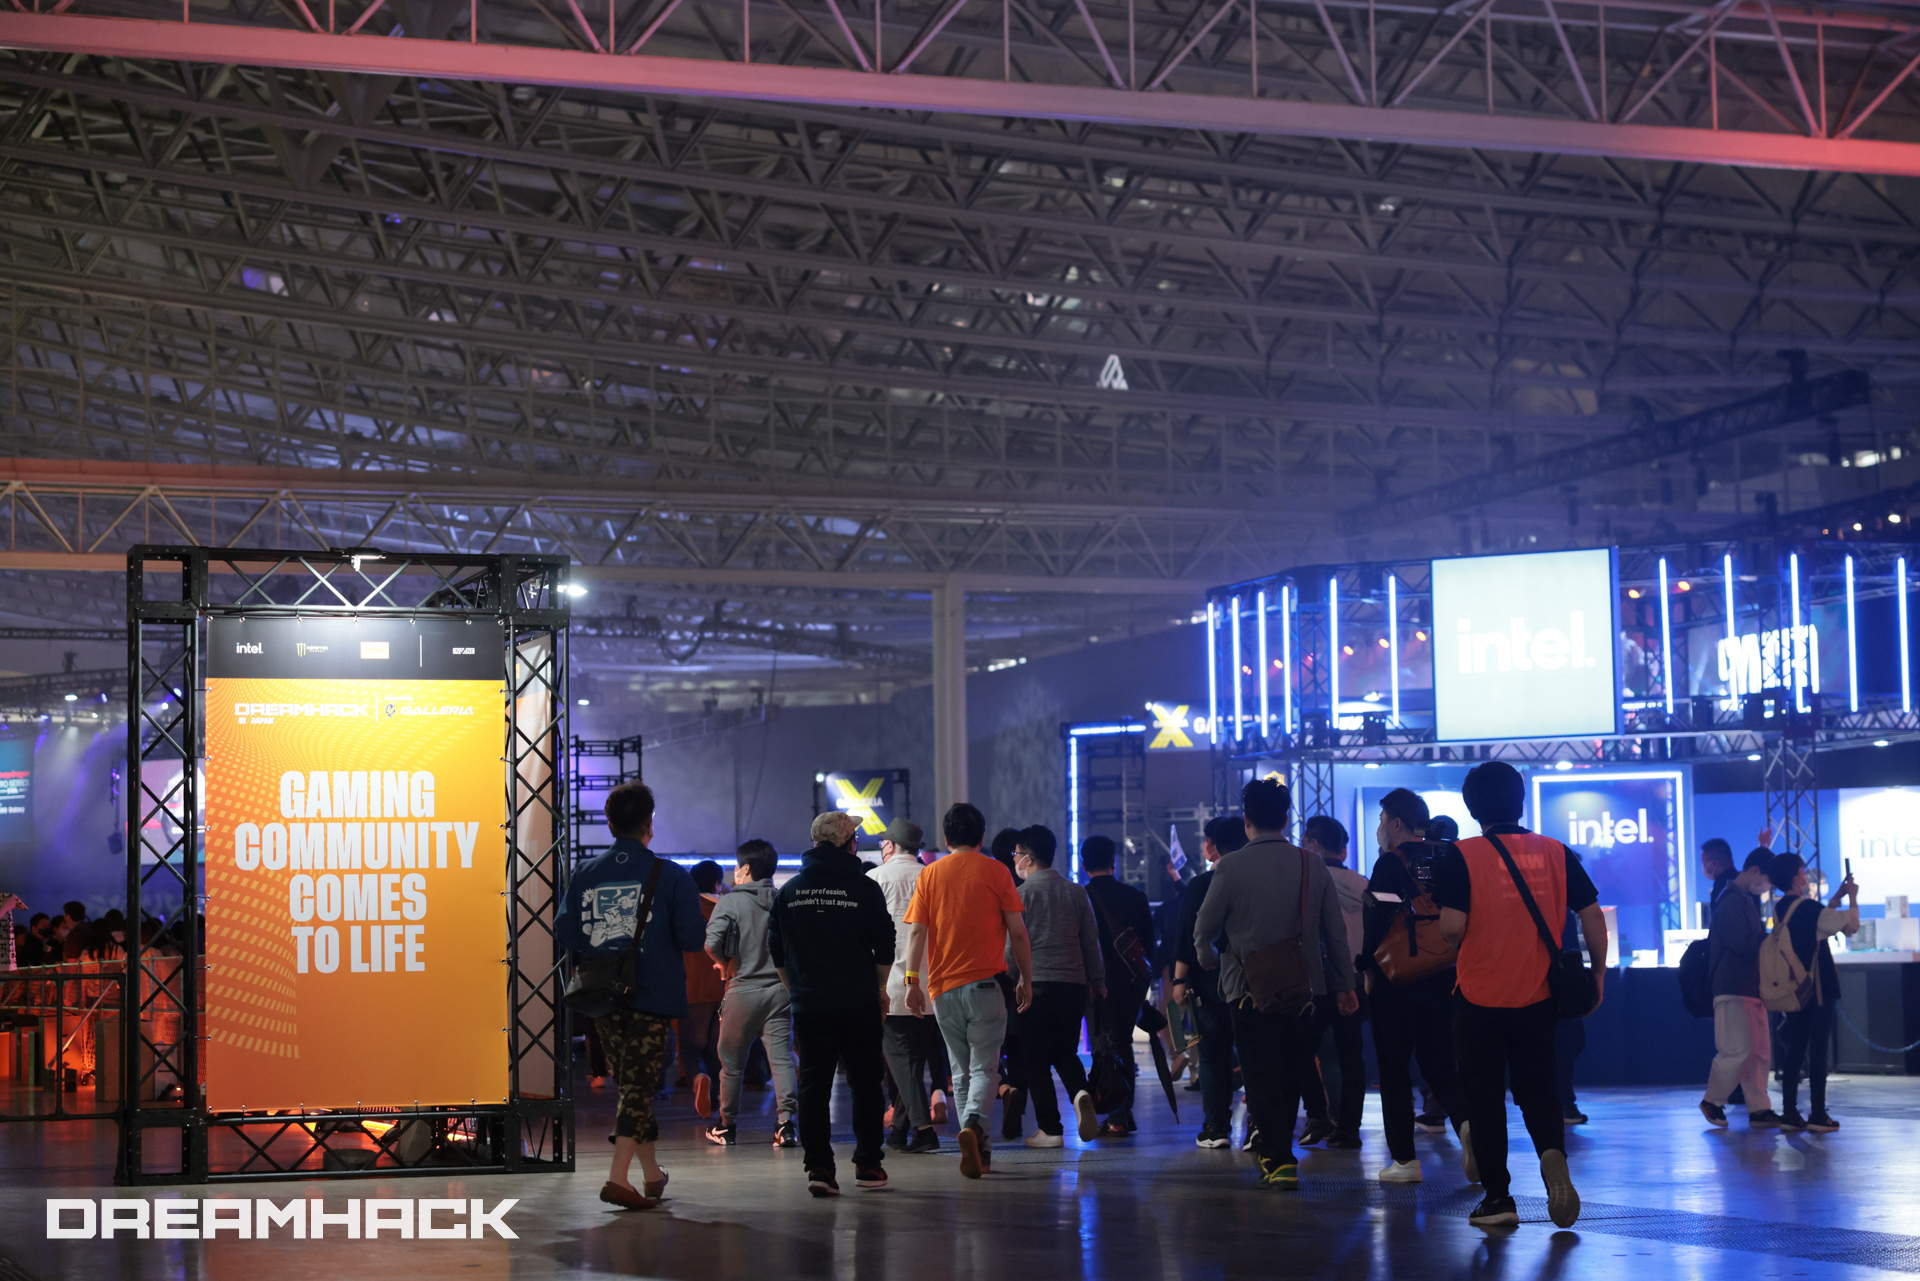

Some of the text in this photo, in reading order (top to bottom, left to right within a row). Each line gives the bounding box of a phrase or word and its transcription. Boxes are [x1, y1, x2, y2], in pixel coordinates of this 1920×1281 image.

[235, 703, 369, 716] DREAMHACK
[400, 706, 474, 715] GALLERIA
[280, 770, 435, 818] GAMING
[1568, 808, 1655, 845] intel.
[235, 822, 480, 870] COMMUNITY
[1860, 830, 1920, 858] inte
[289, 873, 427, 922] COMES
[794, 898, 819, 907] shouldn't
[820, 898, 836, 906] trust
[837, 900, 858, 908] anyone
[811, 888, 848, 897] profession,
[291, 925, 425, 973] TO LIFE
